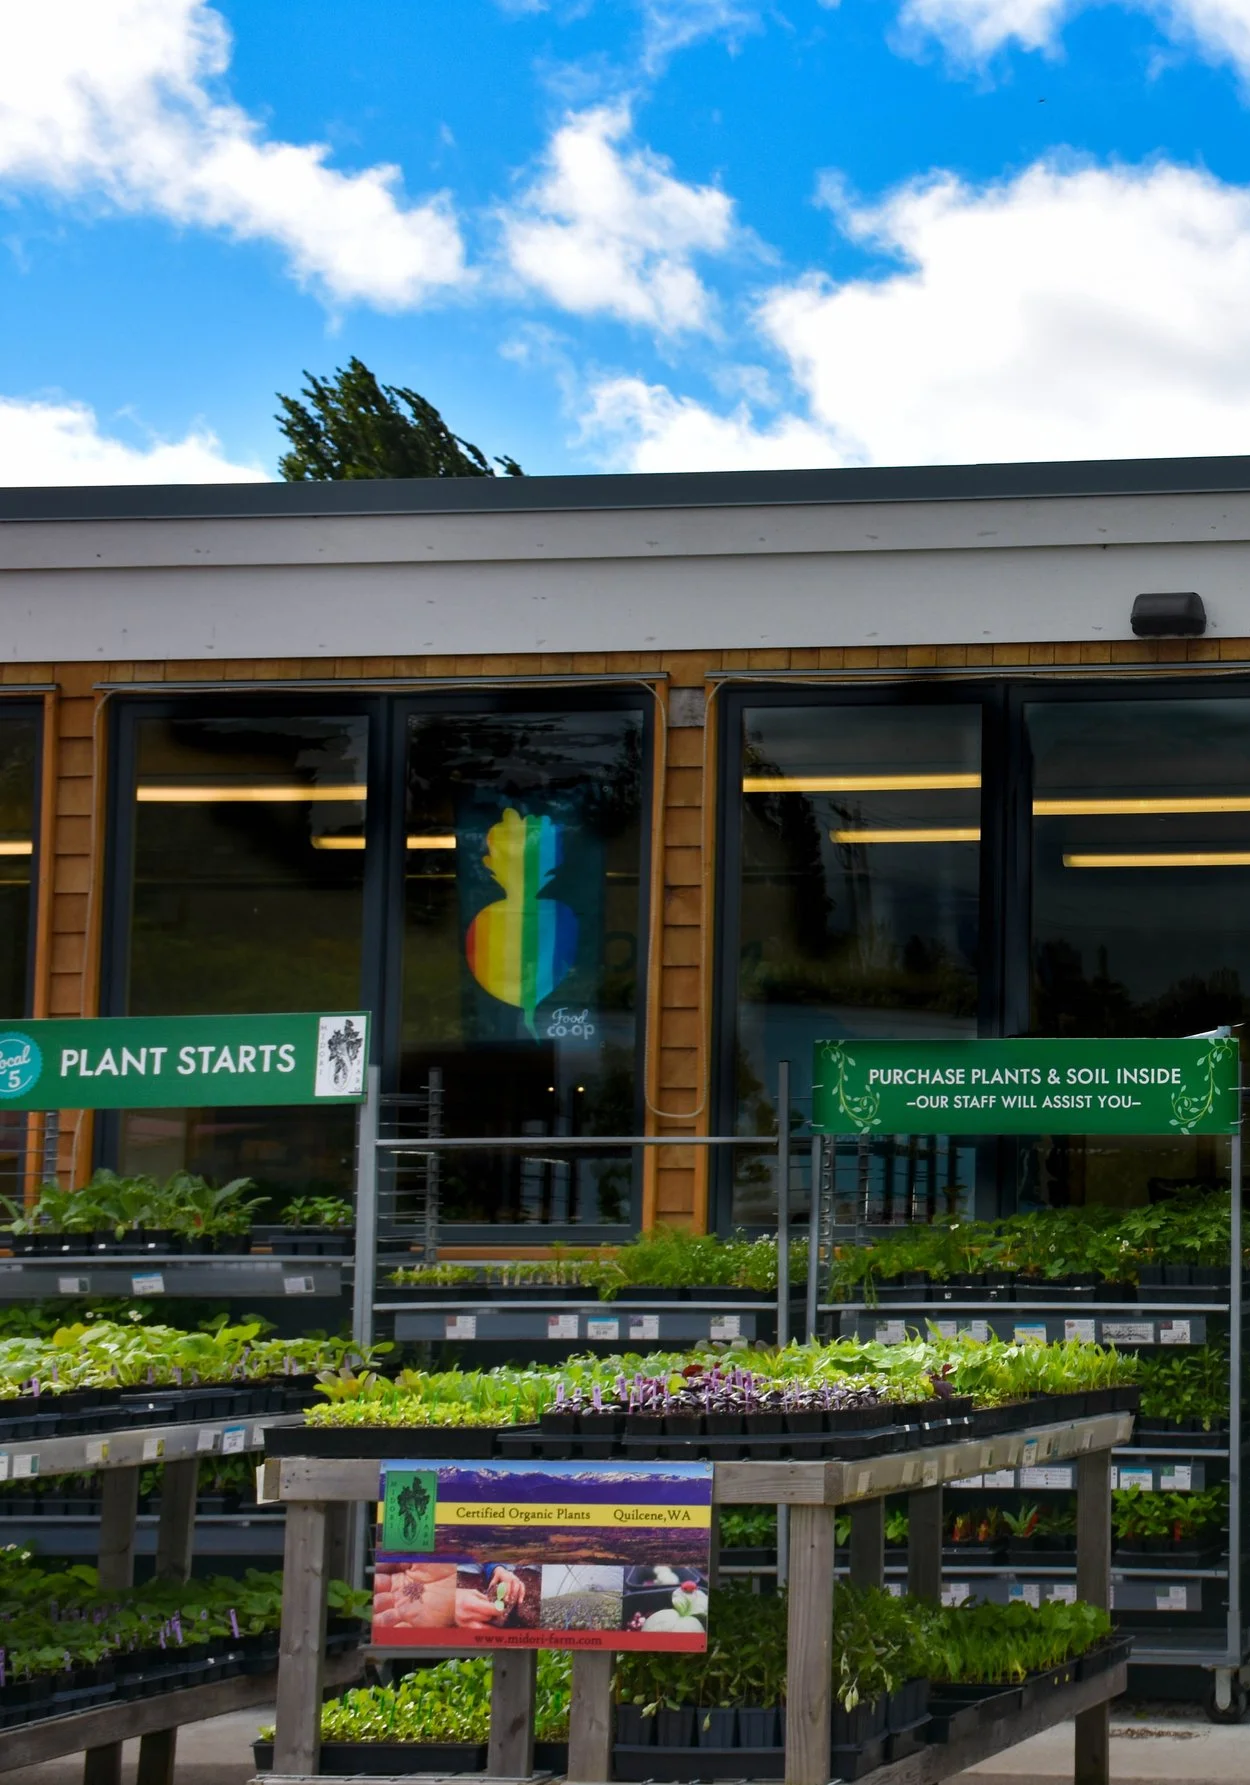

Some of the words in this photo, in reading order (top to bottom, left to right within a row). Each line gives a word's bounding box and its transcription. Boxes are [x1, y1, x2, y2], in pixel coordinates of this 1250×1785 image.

[552, 1007, 589, 1026] Food
[547, 1024, 595, 1040] co-op
[60, 1047, 168, 1077] PLANT
[176, 1044, 296, 1074] STARTS
[8, 1069, 21, 1088] 5
[869, 1068, 965, 1085] PURCHASE
[971, 1068, 1042, 1085] PLANTS
[1047, 1068, 1061, 1085] &
[1066, 1068, 1109, 1085] SOIL
[1116, 1068, 1181, 1084] INSIDE
[953, 1095, 997, 1109] STAFF
[1001, 1095, 1037, 1109] WILL
[1042, 1095, 1093, 1109] ASSIST
[456, 1507, 505, 1520] Certified
[508, 1508, 553, 1523] Organic
[557, 1509, 591, 1520] Plants
[474, 1632, 603, 1647] www.midori-farm.com
